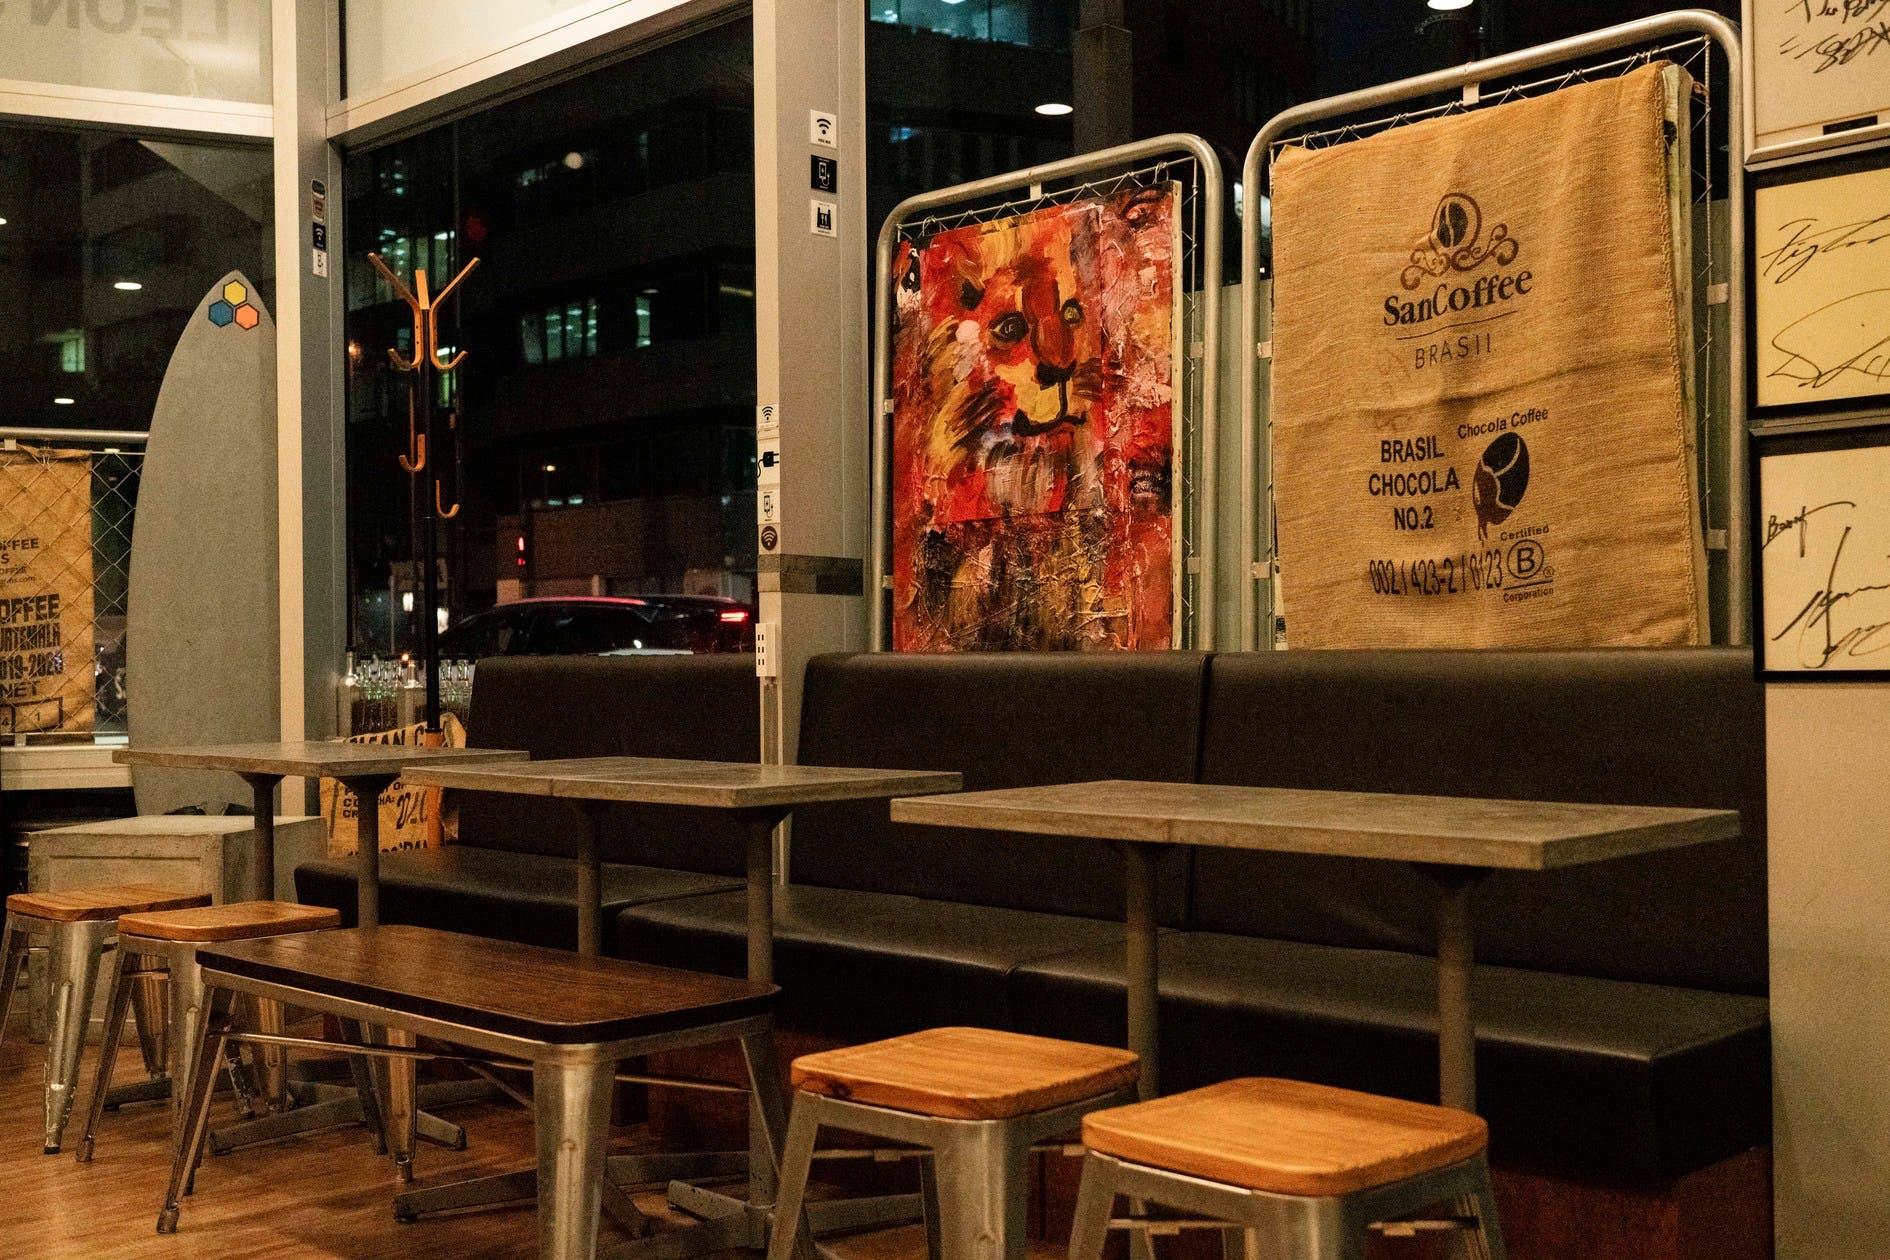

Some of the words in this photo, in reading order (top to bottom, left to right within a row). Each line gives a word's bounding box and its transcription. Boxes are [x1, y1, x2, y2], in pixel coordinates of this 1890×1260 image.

[1384, 271, 1532, 326] SanCoffee
[1457, 417, 1507, 439] Chocola
[1511, 407, 1549, 428] Coffee
[1381, 435, 1445, 463] BRASIL
[1368, 467, 1460, 496] CHOCOLA
[1393, 505, 1435, 531] NO.2
[1500, 522, 1549, 541] Certified
[1503, 587, 1554, 603] Corporation
